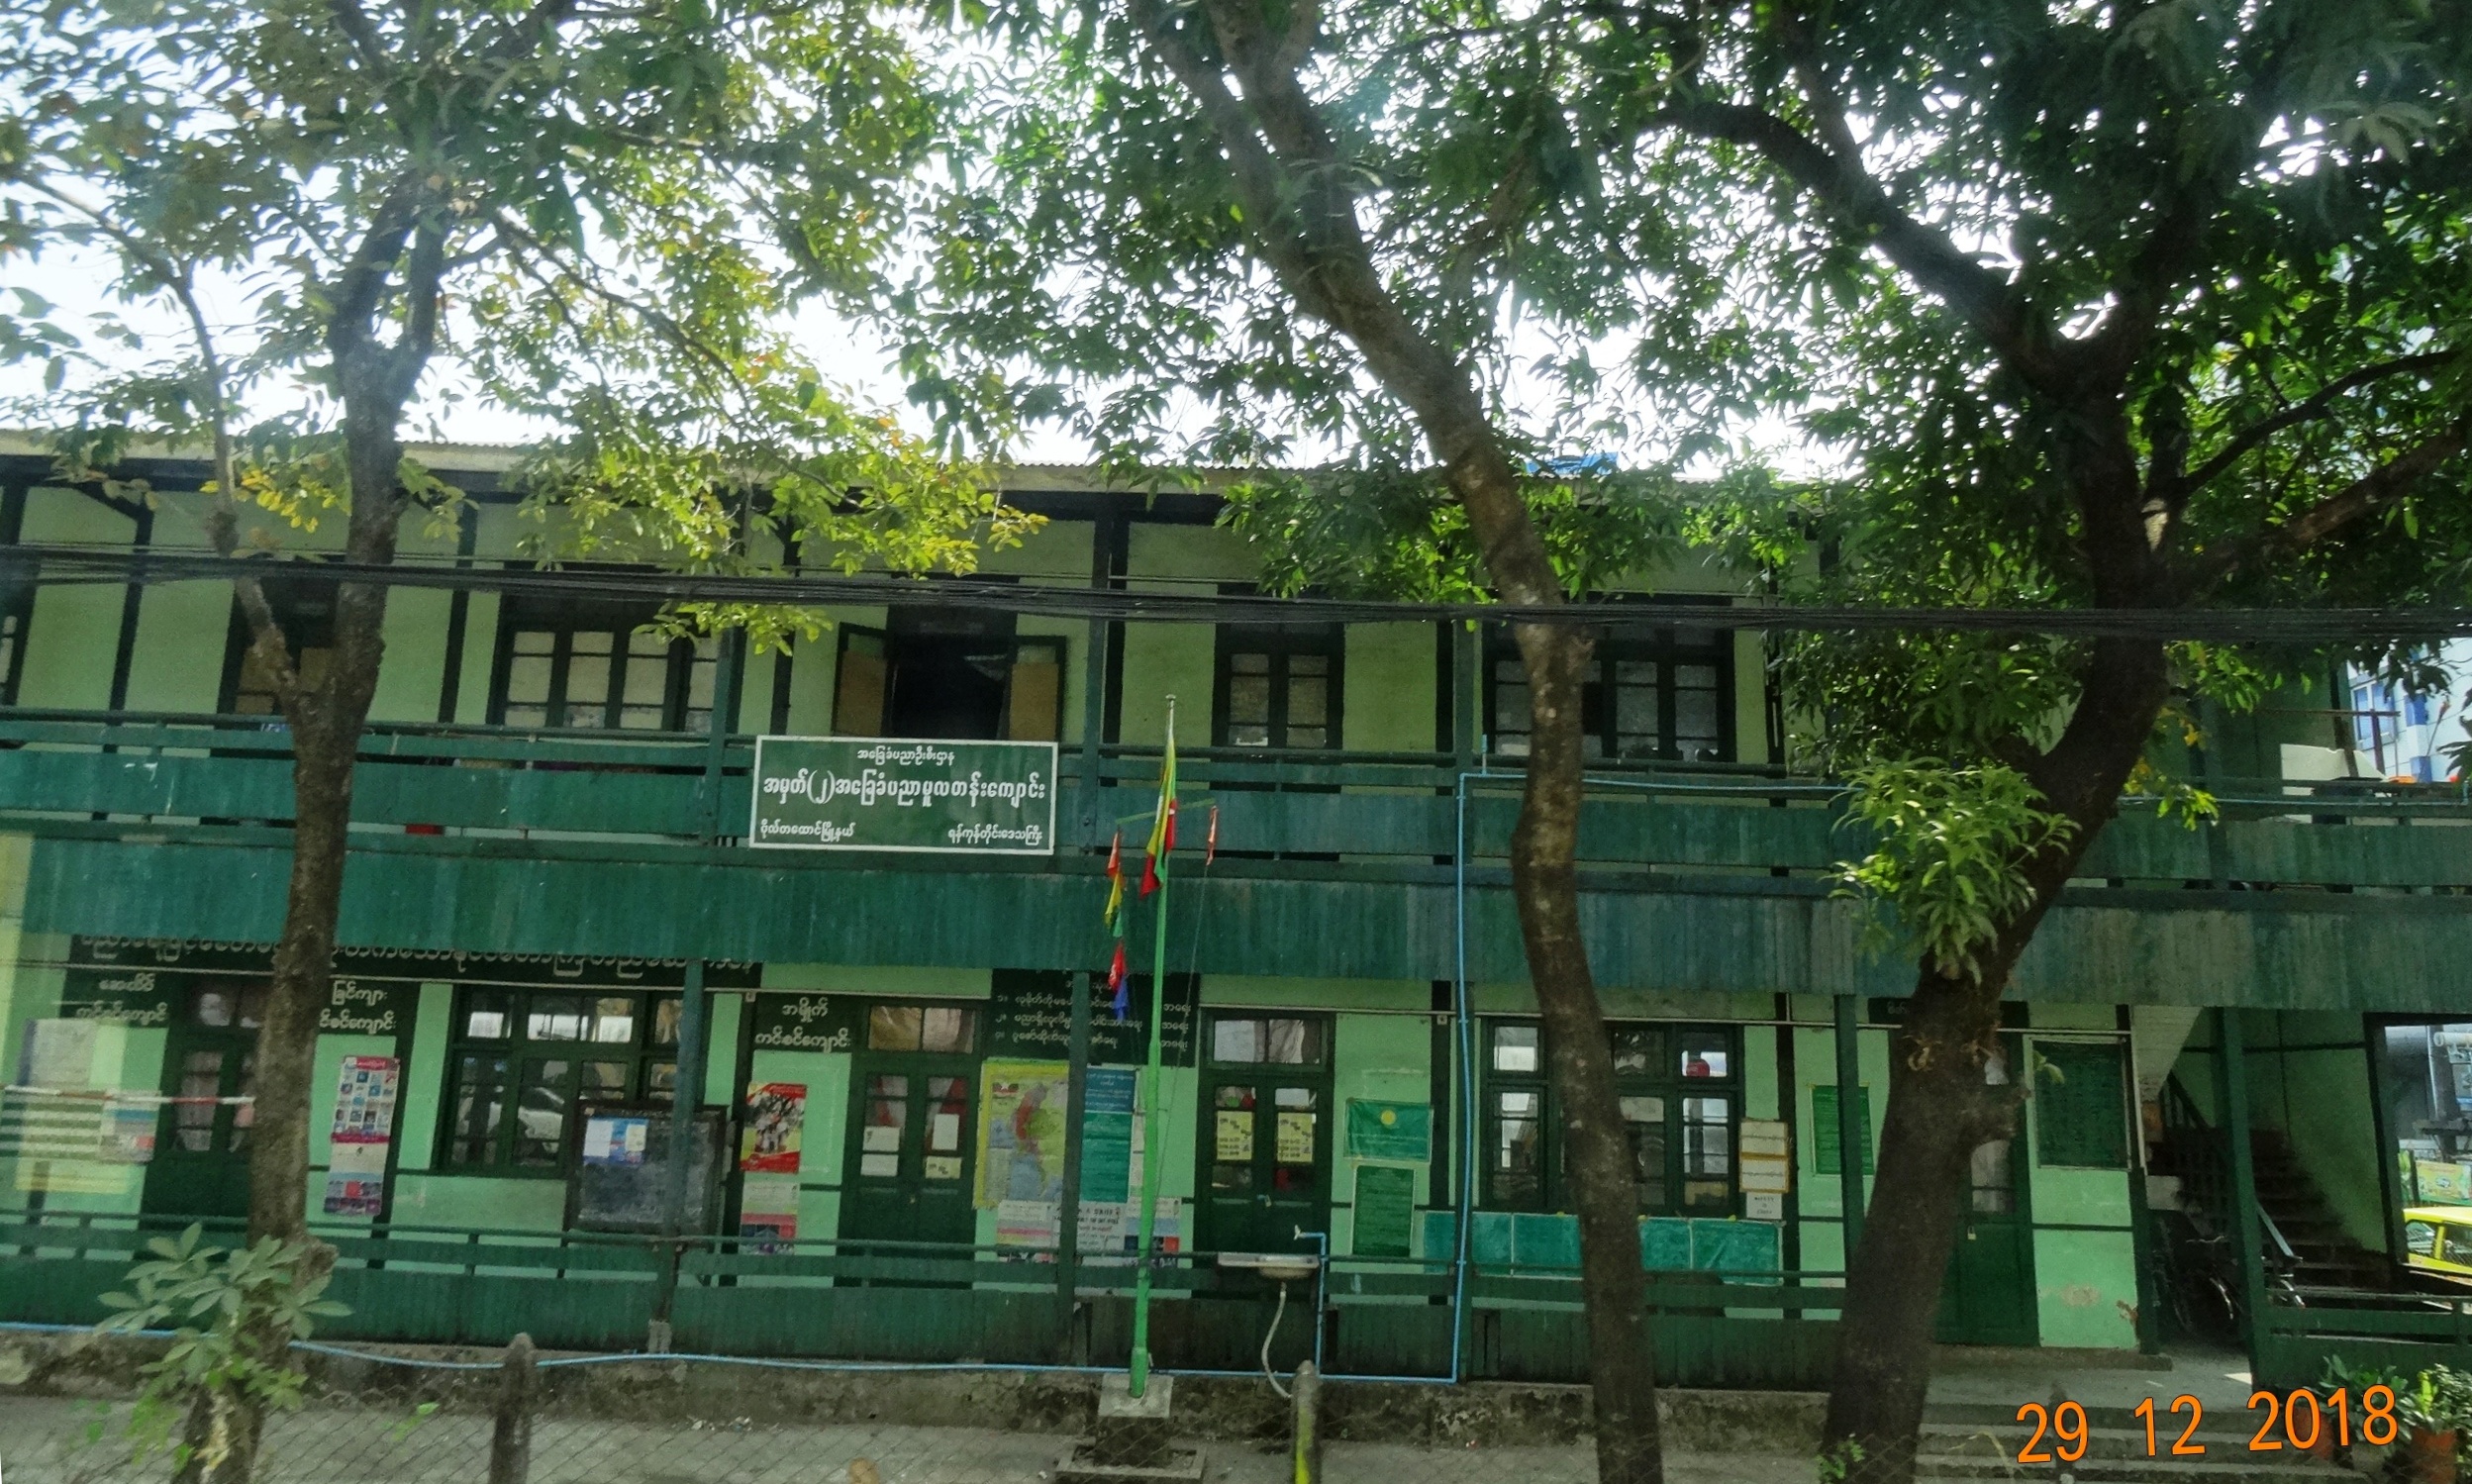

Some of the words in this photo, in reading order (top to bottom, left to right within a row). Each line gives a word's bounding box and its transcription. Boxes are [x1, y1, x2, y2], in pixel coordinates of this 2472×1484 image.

[856, 744, 955, 766] အခြေခံပညာဦးစီးဌာန
[947, 823, 1043, 846] ရန်ကုန်တိုင်းဒေသကြီး
